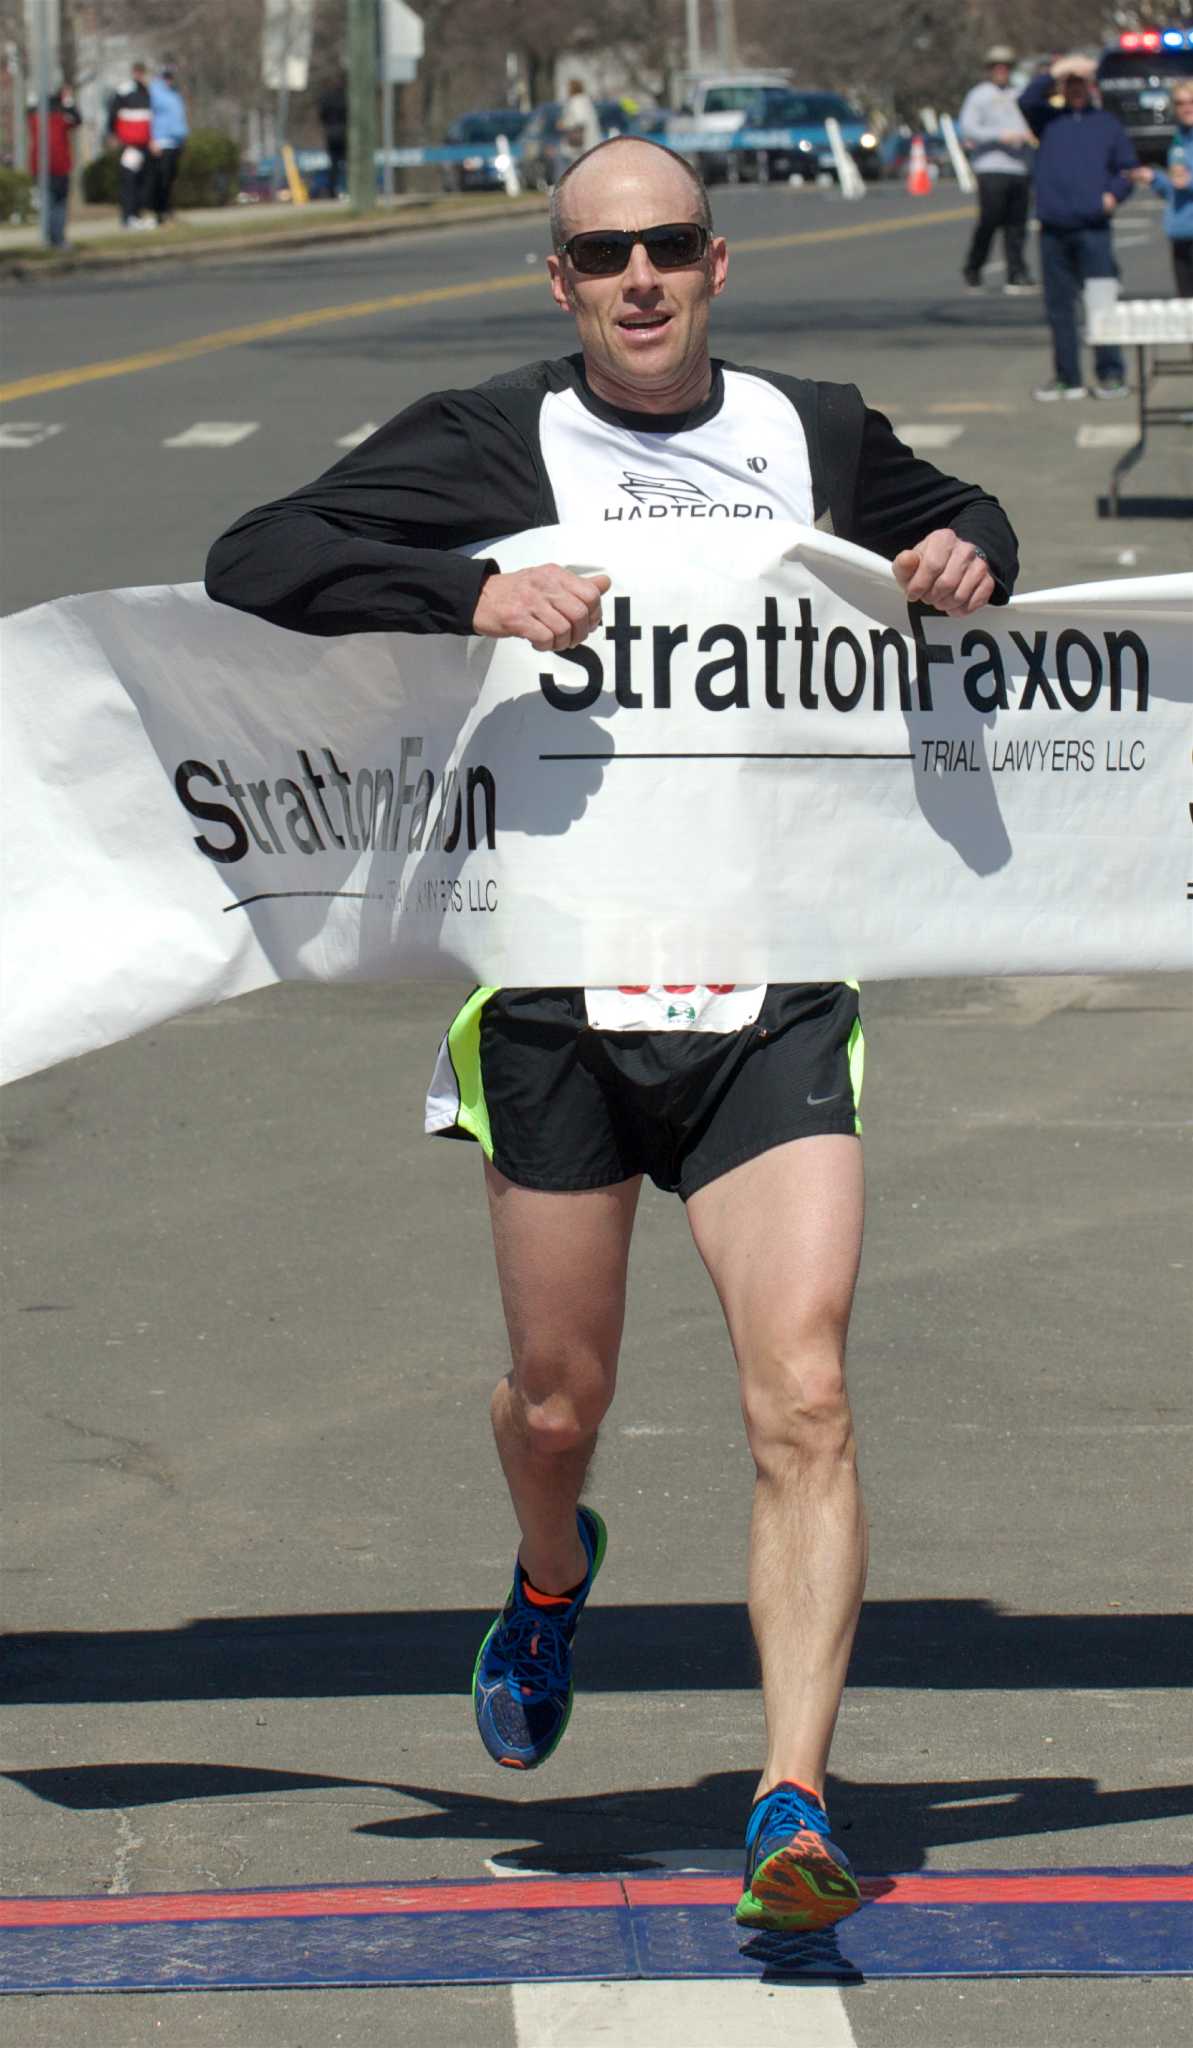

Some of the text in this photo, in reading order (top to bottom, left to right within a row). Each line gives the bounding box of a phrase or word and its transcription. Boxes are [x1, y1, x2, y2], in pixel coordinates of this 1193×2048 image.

[538, 596, 1150, 713] StrattonFaxon
[921, 739, 1147, 773] TRIAL LAWYERS LLC
[468, 879, 498, 912] LLC
